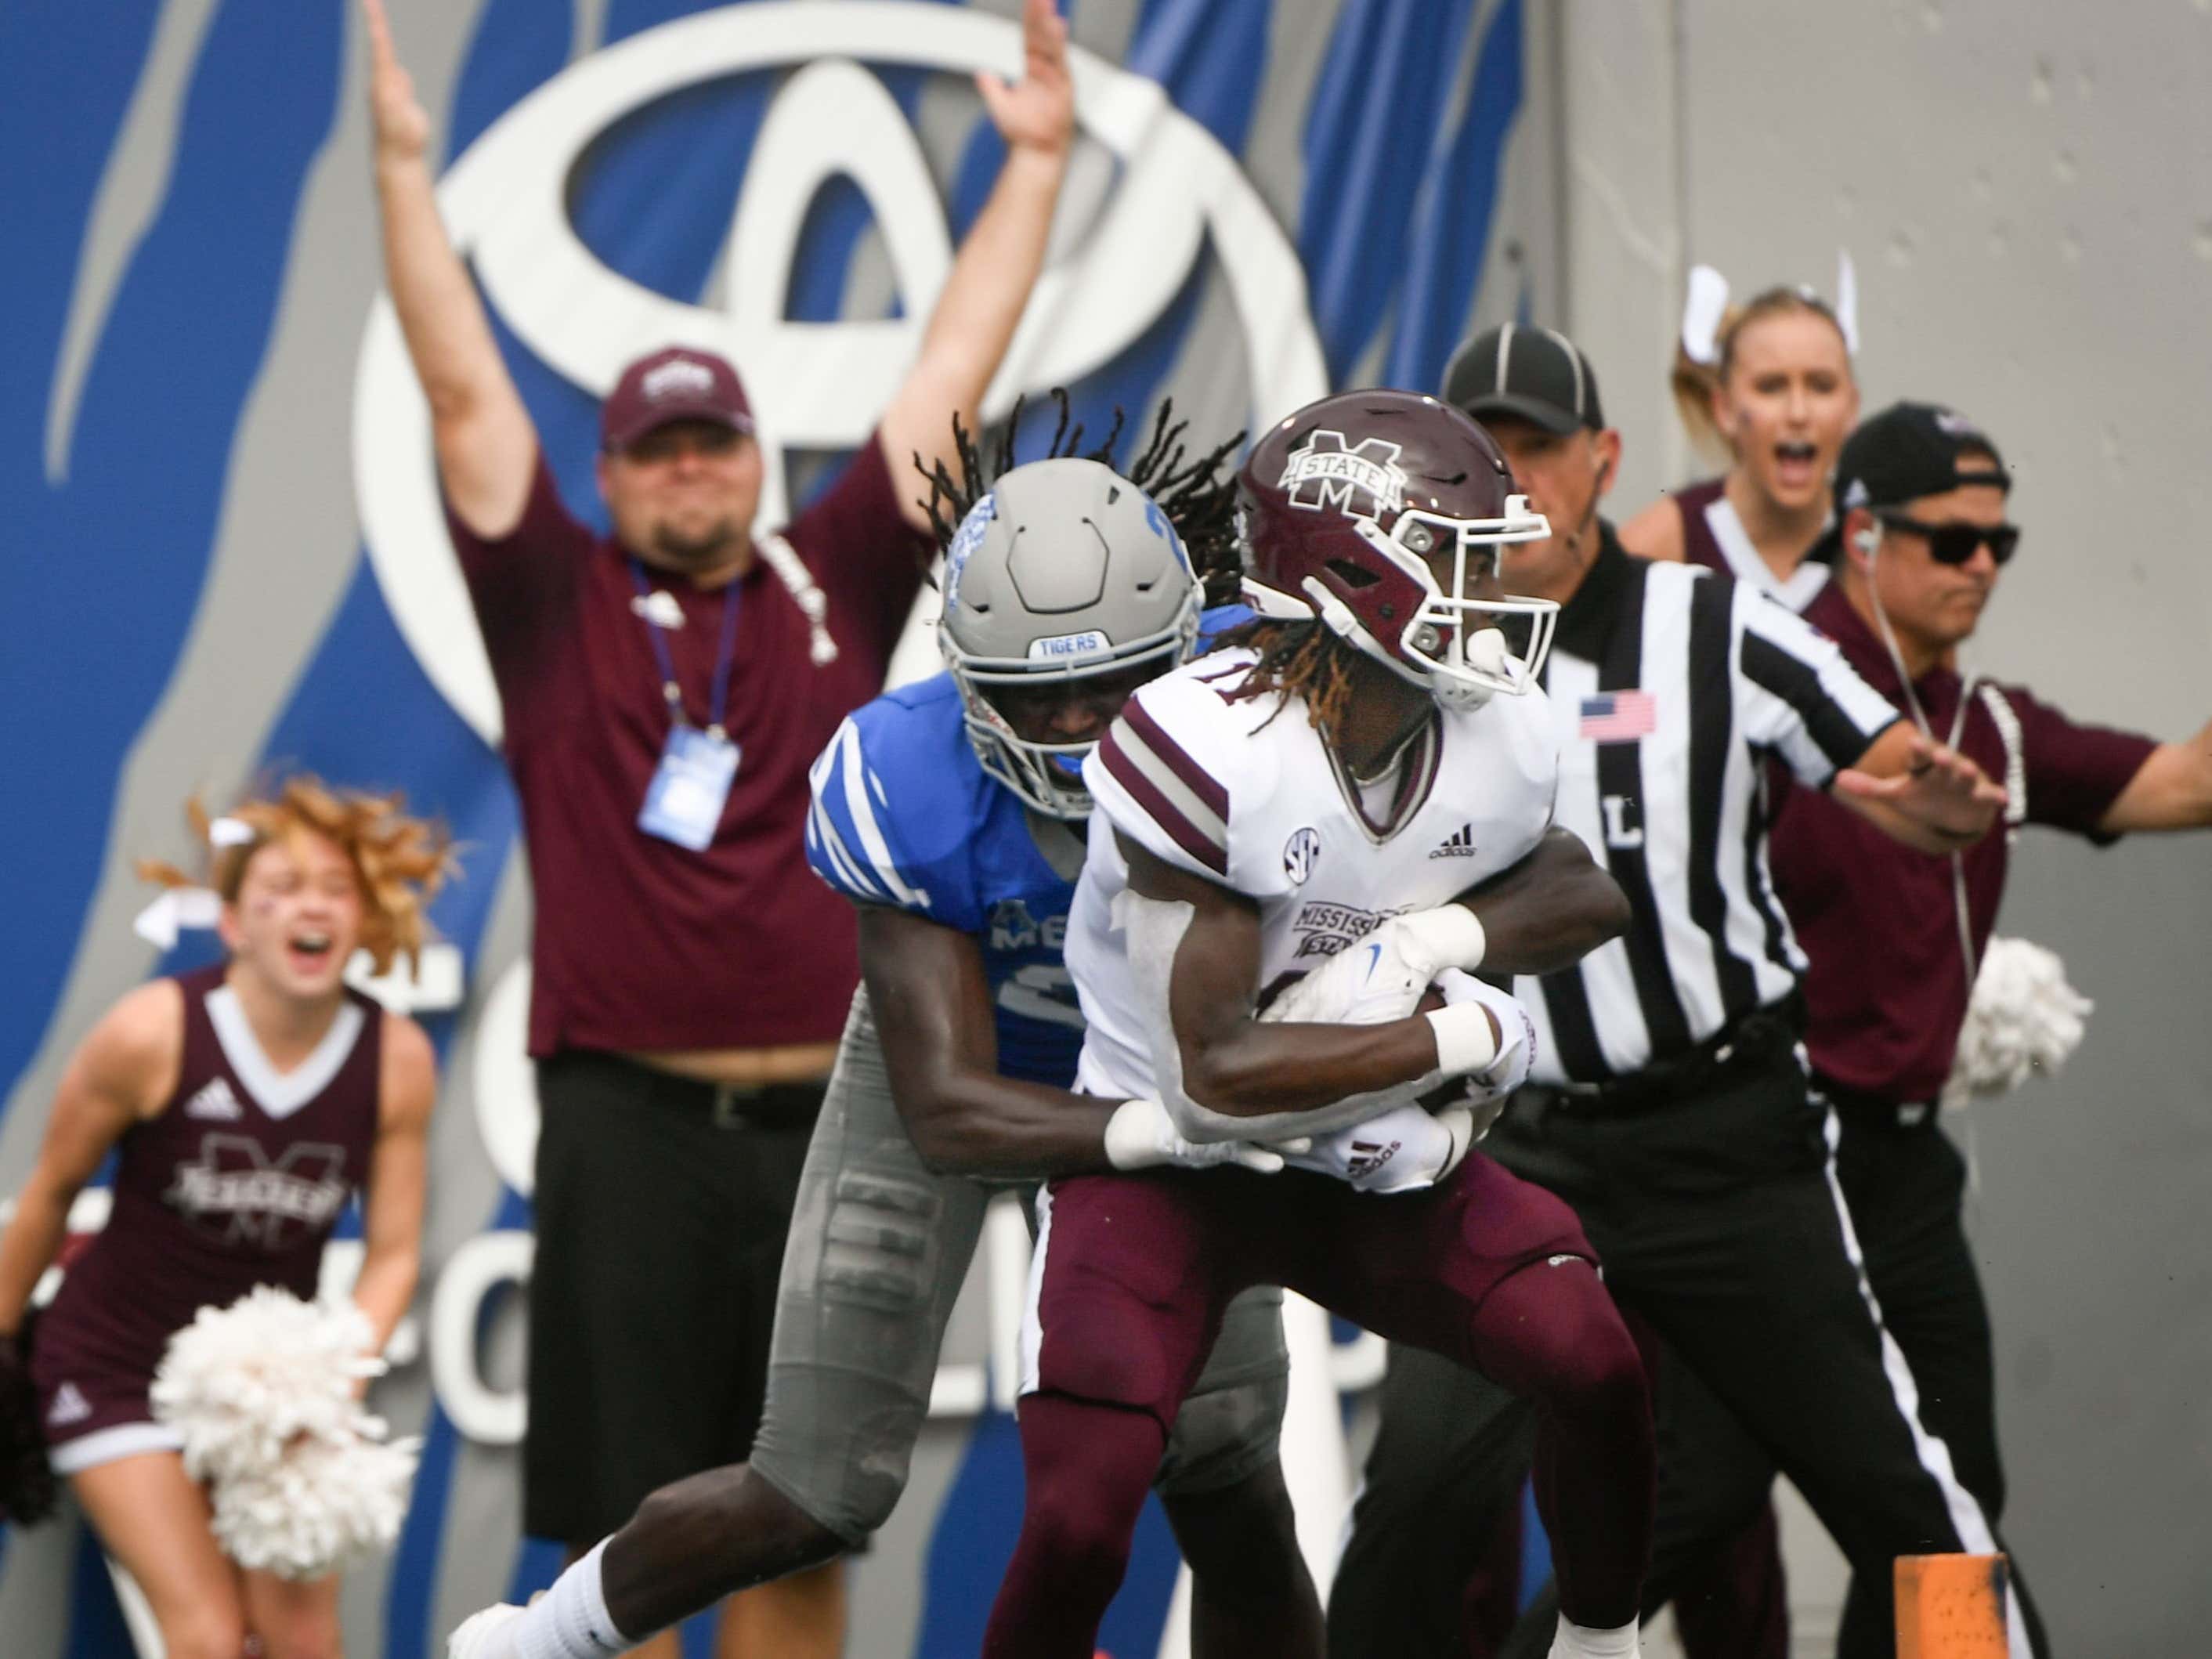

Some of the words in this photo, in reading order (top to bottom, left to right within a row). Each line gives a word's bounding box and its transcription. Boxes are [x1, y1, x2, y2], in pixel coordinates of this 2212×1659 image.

[1305, 455, 1380, 490] STATE
[1039, 634, 1097, 656] TIGERS
[1602, 793, 1643, 848] L
[1429, 846, 1477, 860] adidas
